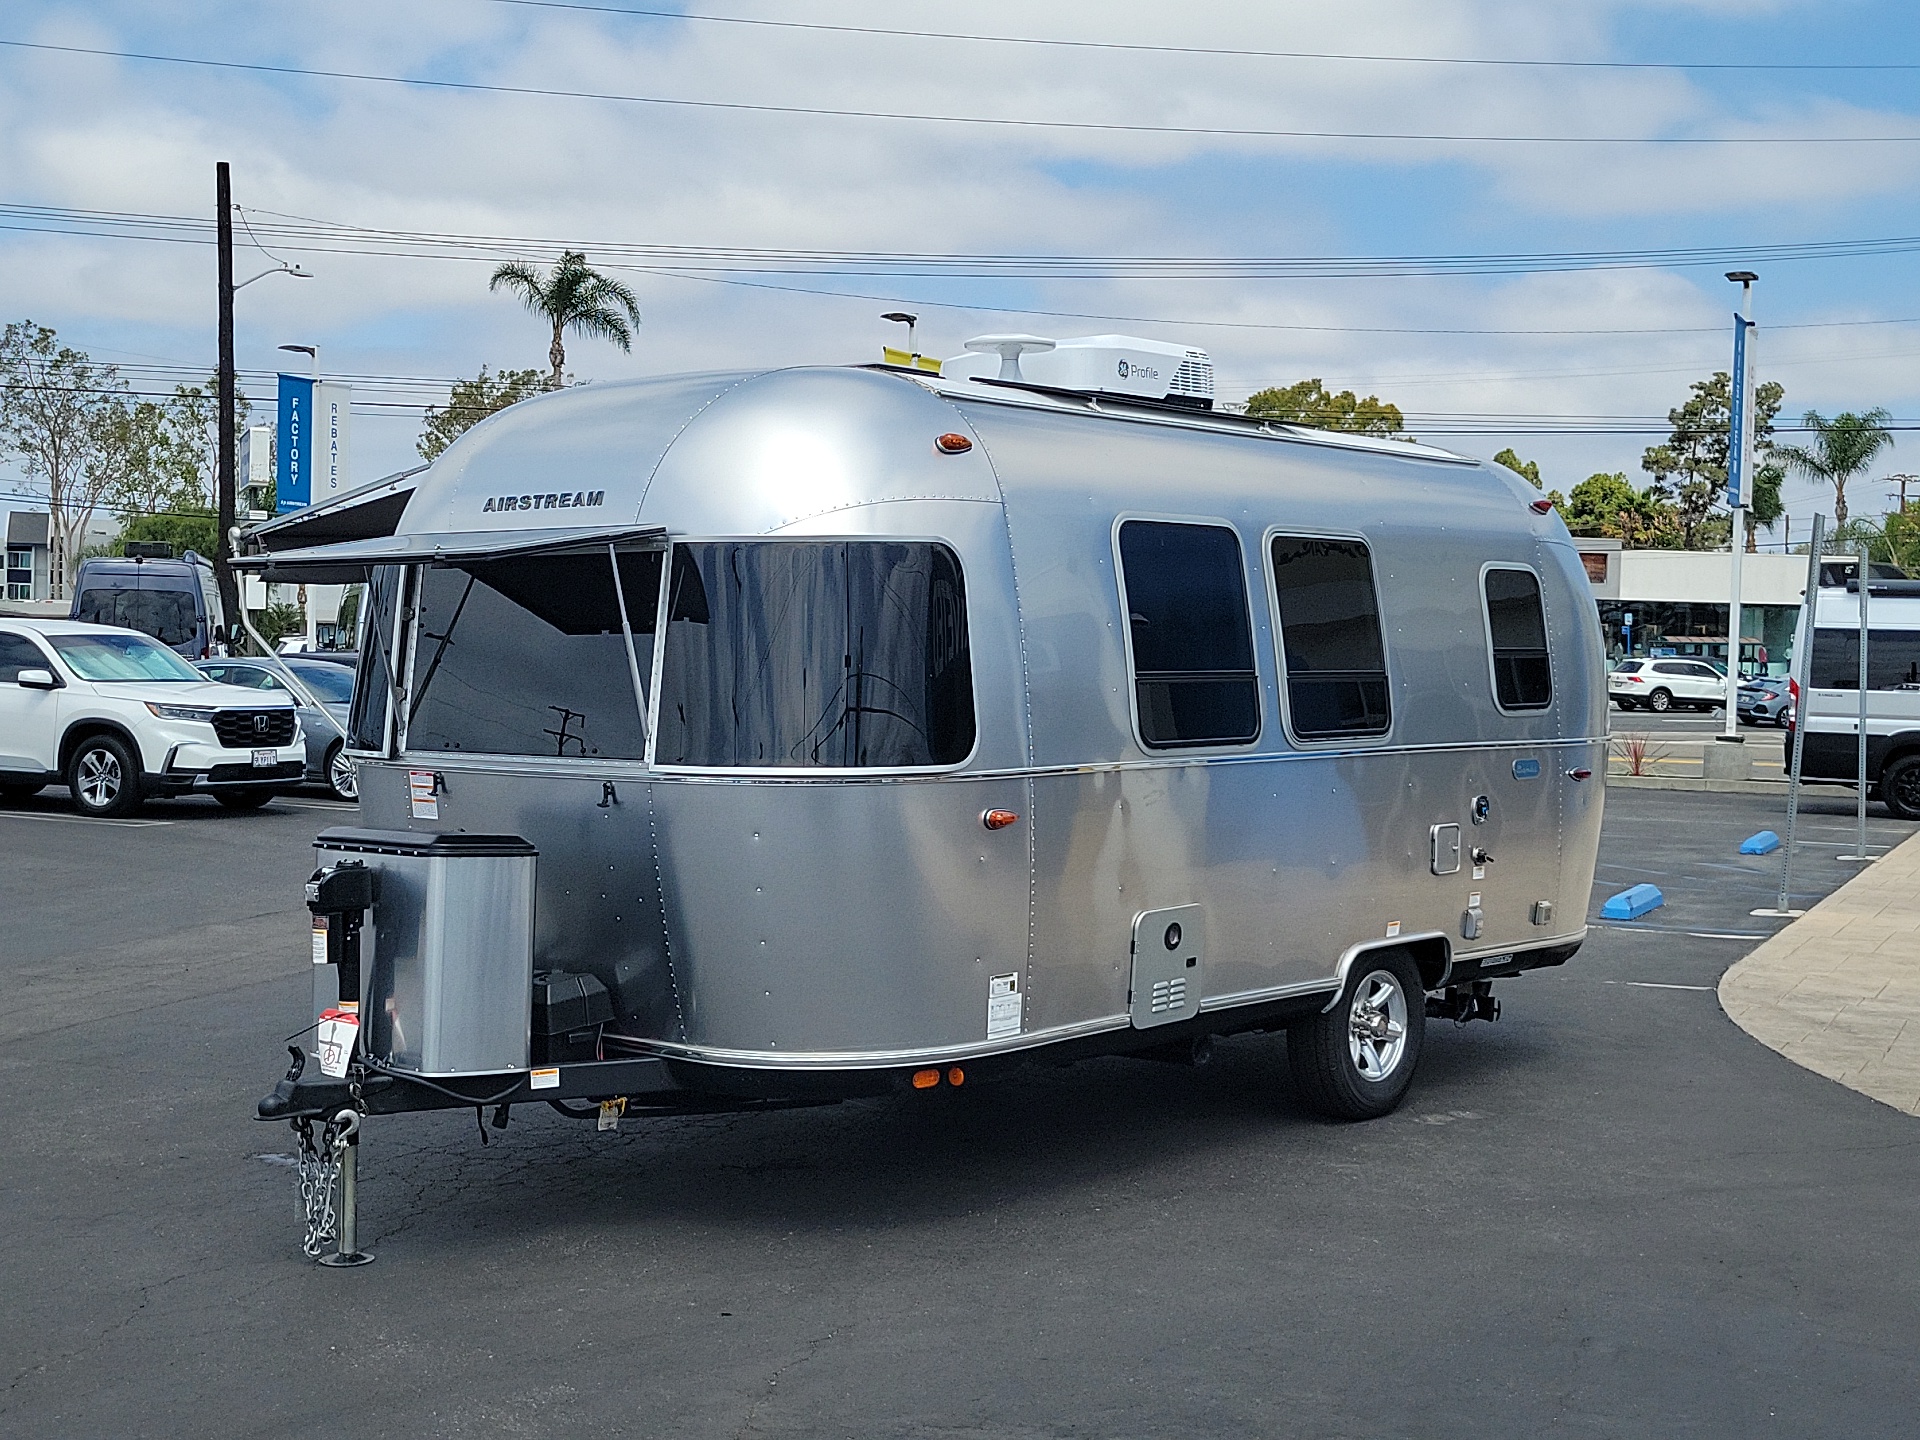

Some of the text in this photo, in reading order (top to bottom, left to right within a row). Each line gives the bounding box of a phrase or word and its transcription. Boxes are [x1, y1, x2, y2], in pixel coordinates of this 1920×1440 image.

[1131, 364, 1159, 380] Profile
[291, 398, 299, 485] FACTORY
[482, 490, 605, 513] AIRSTREAM
